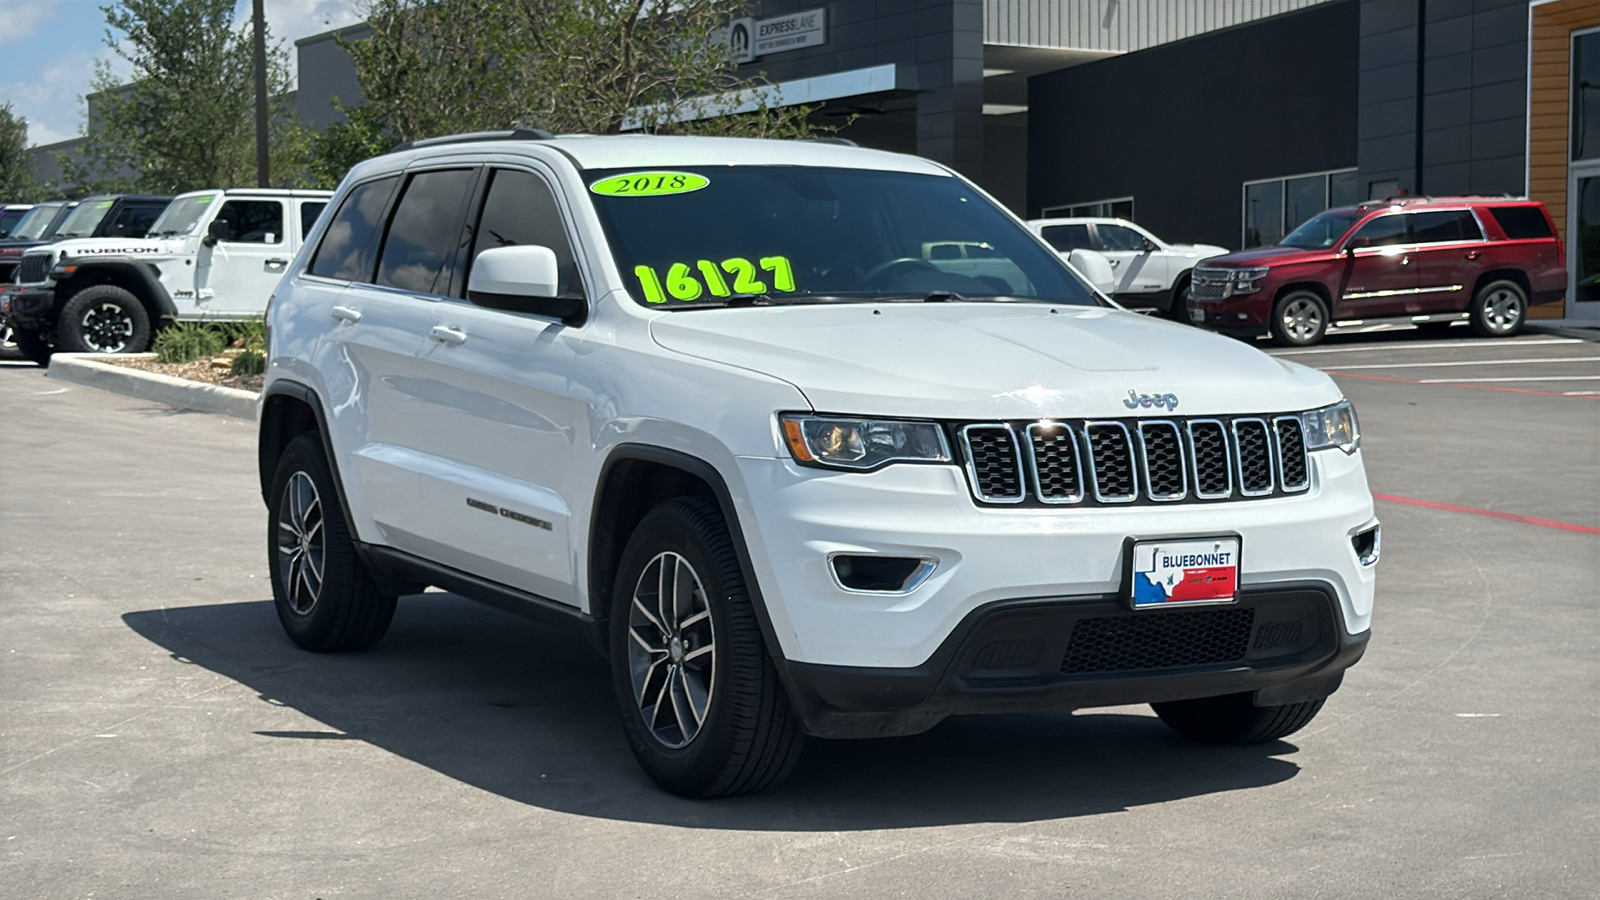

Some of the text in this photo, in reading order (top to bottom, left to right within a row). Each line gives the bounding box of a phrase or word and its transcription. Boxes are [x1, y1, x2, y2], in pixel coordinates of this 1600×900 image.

[614, 175, 687, 193] 2018
[634, 256, 795, 303] 16127
[1123, 389, 1178, 412] Jeep
[1163, 553, 1231, 568] BLUEBONNET
